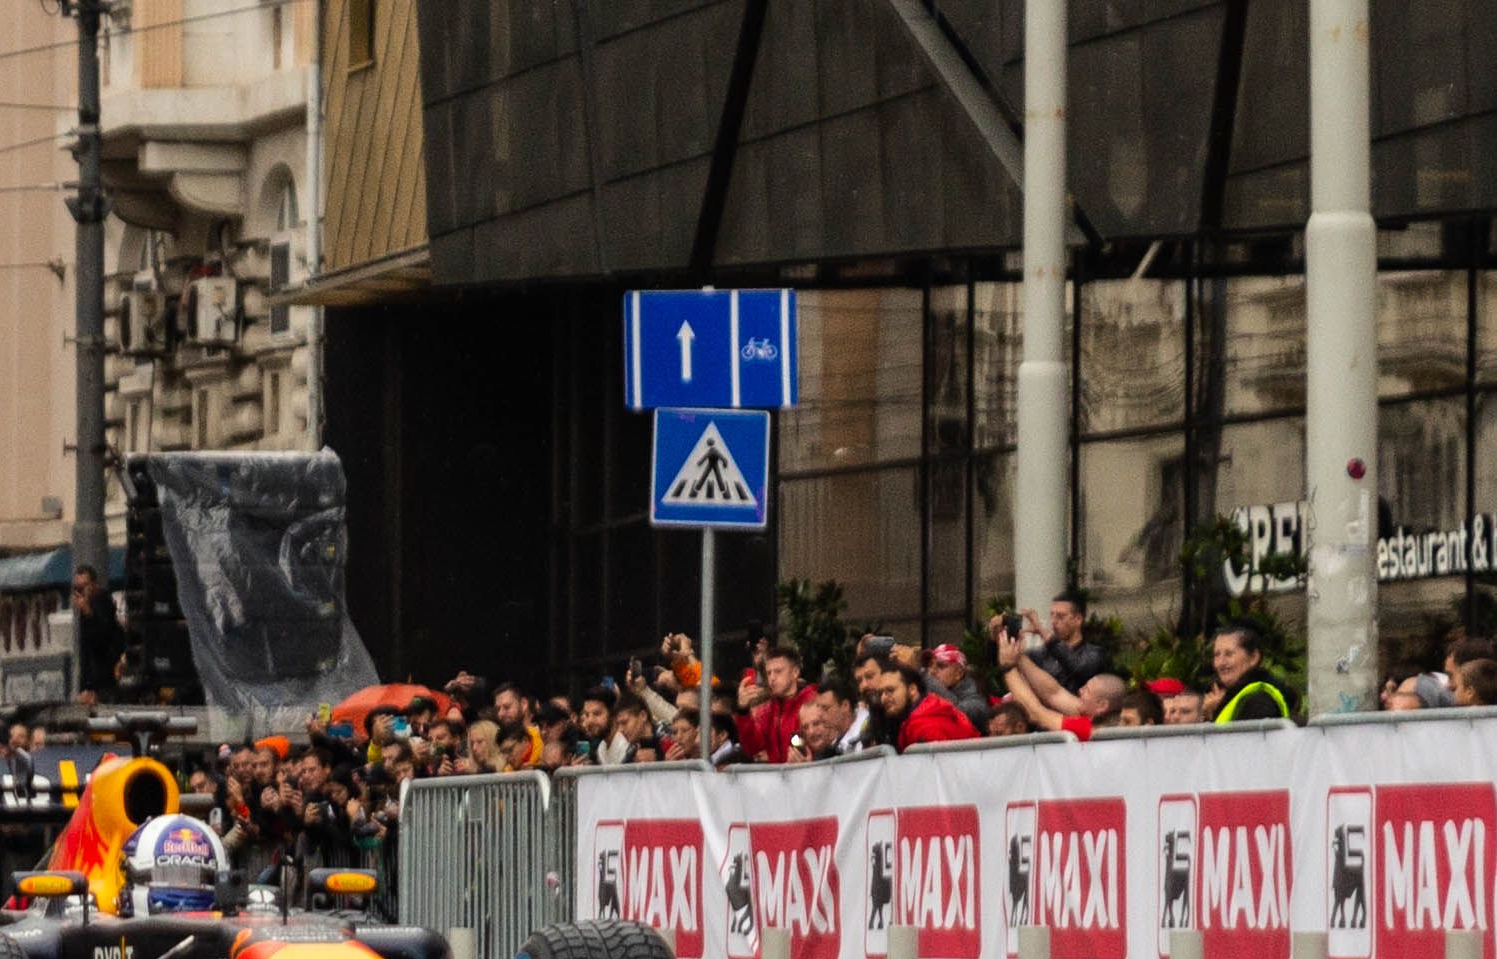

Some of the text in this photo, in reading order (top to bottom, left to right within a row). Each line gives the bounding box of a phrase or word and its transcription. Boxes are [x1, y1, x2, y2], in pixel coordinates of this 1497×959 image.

[1377, 522, 1467, 578] estaurant
[156, 855, 217, 868] ORACLE
[627, 844, 698, 931] MAXI
[756, 844, 834, 935] MAXI
[902, 834, 975, 930] MAXI
[1040, 828, 1119, 929] MAXI
[1202, 823, 1289, 930] MAXI
[1383, 817, 1487, 930] MAXI
